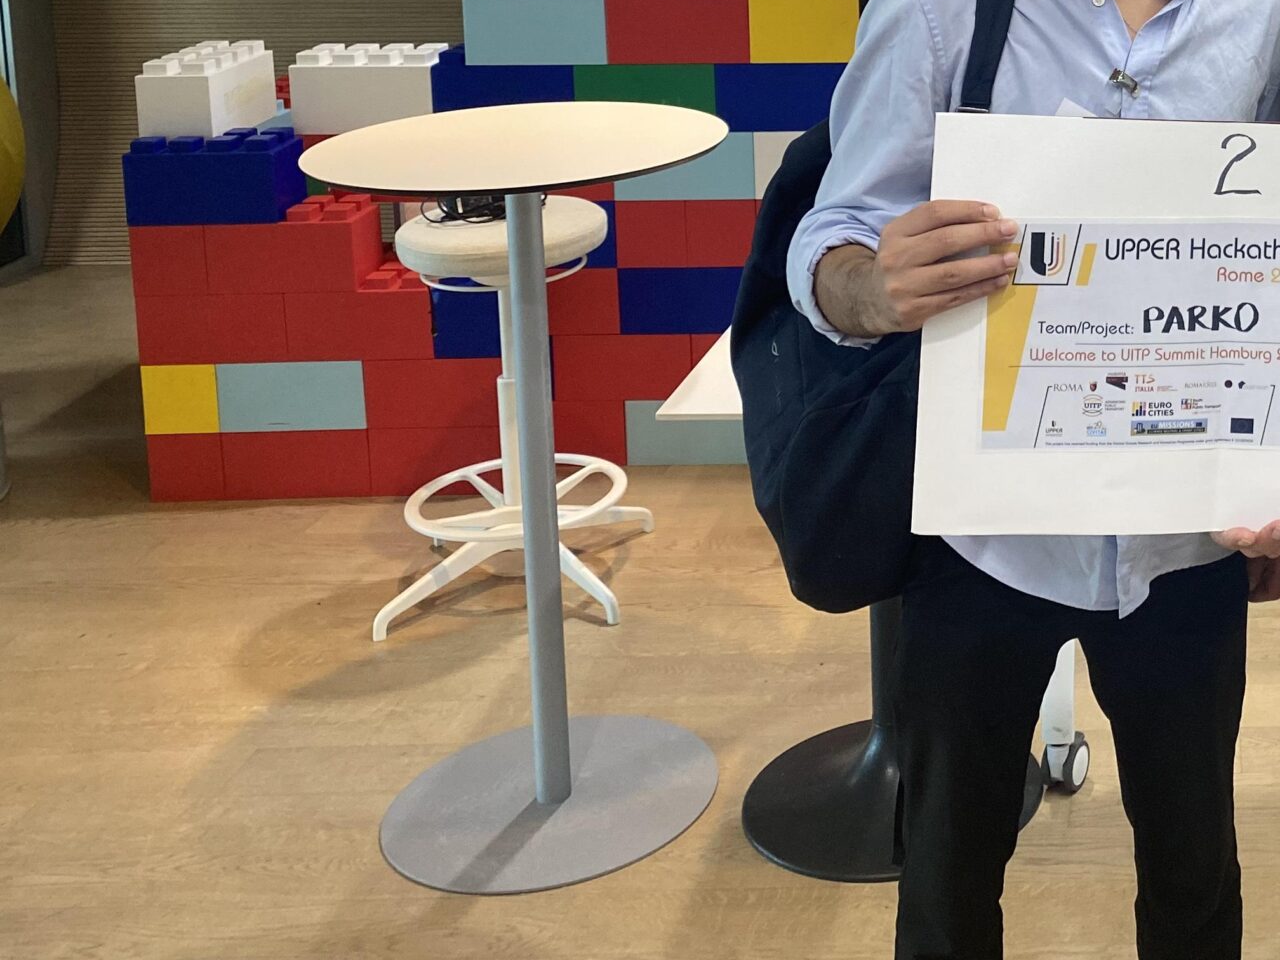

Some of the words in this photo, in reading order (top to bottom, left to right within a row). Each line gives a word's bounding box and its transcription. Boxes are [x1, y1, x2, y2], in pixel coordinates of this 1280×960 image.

[1214, 133, 1262, 195] 2
[1105, 237, 1180, 261] UPPER
[1216, 266, 1265, 283] Rome
[1142, 301, 1260, 334] PARKO
[1037, 320, 1135, 336] Team/Project:
[1029, 347, 1096, 362] Welcome
[1101, 348, 1117, 362] to
[1120, 347, 1150, 362] UITP
[1154, 347, 1206, 362] Summit
[1209, 346, 1272, 363] Hamburg
[1134, 373, 1156, 384] TTS
[1052, 383, 1083, 392] ROMA
[1134, 385, 1154, 393] ITALIA
[1148, 409, 1174, 417] CITIES
[1158, 421, 1195, 429] MISSIONS
